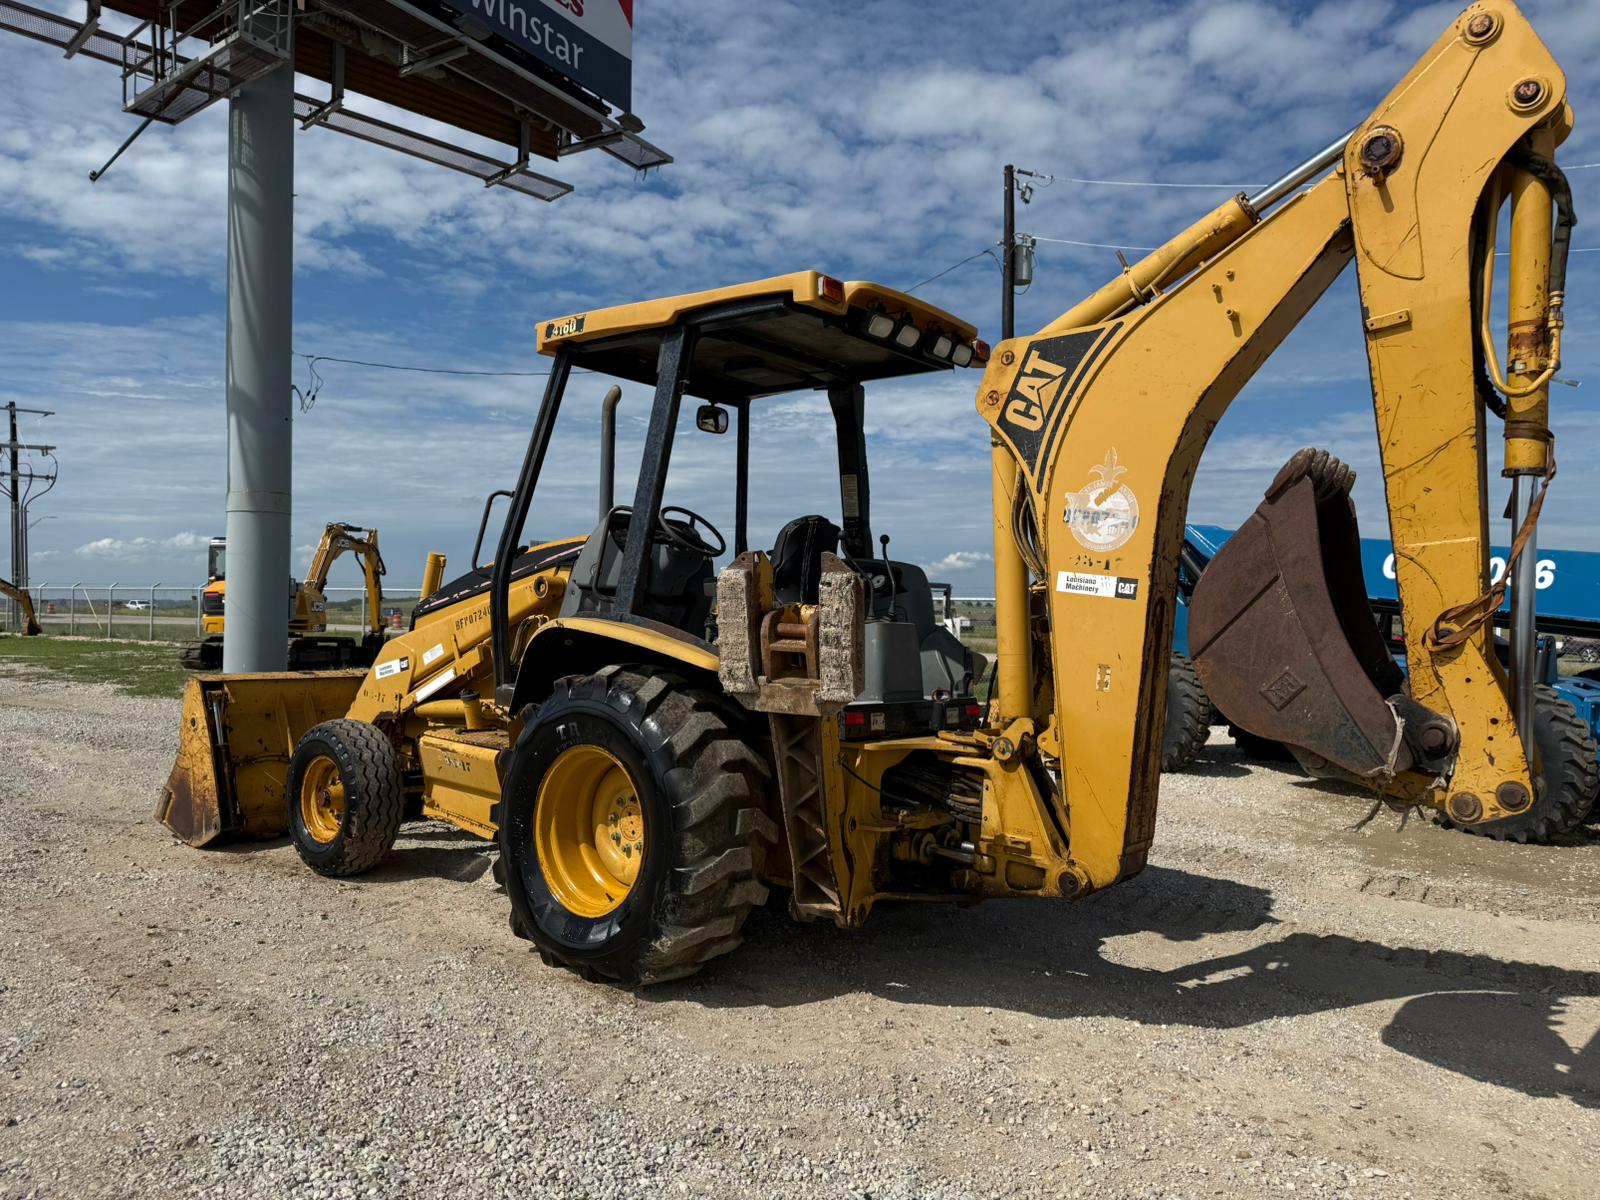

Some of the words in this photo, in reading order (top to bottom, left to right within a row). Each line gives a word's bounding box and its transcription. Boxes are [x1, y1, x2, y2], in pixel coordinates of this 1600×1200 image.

[1005, 350, 1067, 431] CAT
[1066, 575, 1097, 585] Louisiana
[1065, 582, 1099, 594] Machinery
[1117, 582, 1137, 594] CAT
